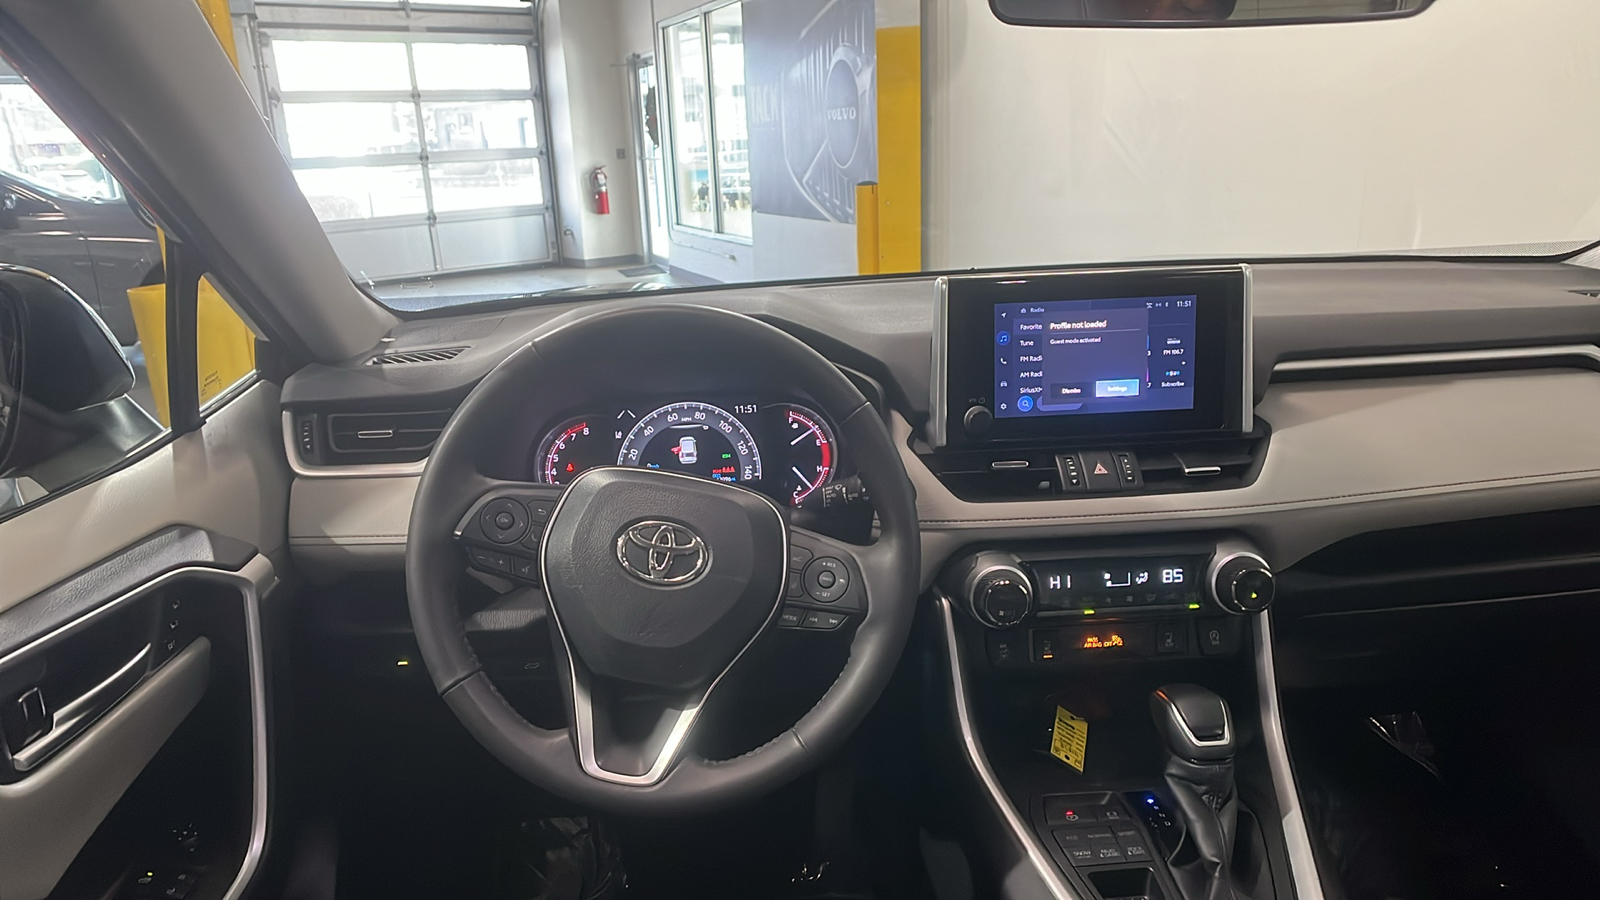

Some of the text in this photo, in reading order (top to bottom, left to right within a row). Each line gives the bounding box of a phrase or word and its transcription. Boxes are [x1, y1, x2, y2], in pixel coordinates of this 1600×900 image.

[827, 107, 857, 120] VOLVO
[1176, 300, 1192, 308] 11:51
[1050, 319, 1107, 330] Profile not loaded
[734, 404, 758, 414] 11:51
[667, 412, 679, 423] 60
[694, 411, 706, 421] 80
[582, 427, 590, 436] 8
[643, 425, 655, 437] 40
[718, 420, 733, 434] 100
[570, 432, 577, 441] 7
[559, 442, 566, 450] 6
[736, 440, 749, 456] 120
[553, 453, 559, 463] 5
[628, 448, 639, 461] 20
[550, 467, 558, 476] 4
[744, 464, 753, 480] 140
[816, 465, 823, 473] H
[1162, 568, 1184, 584] 85
